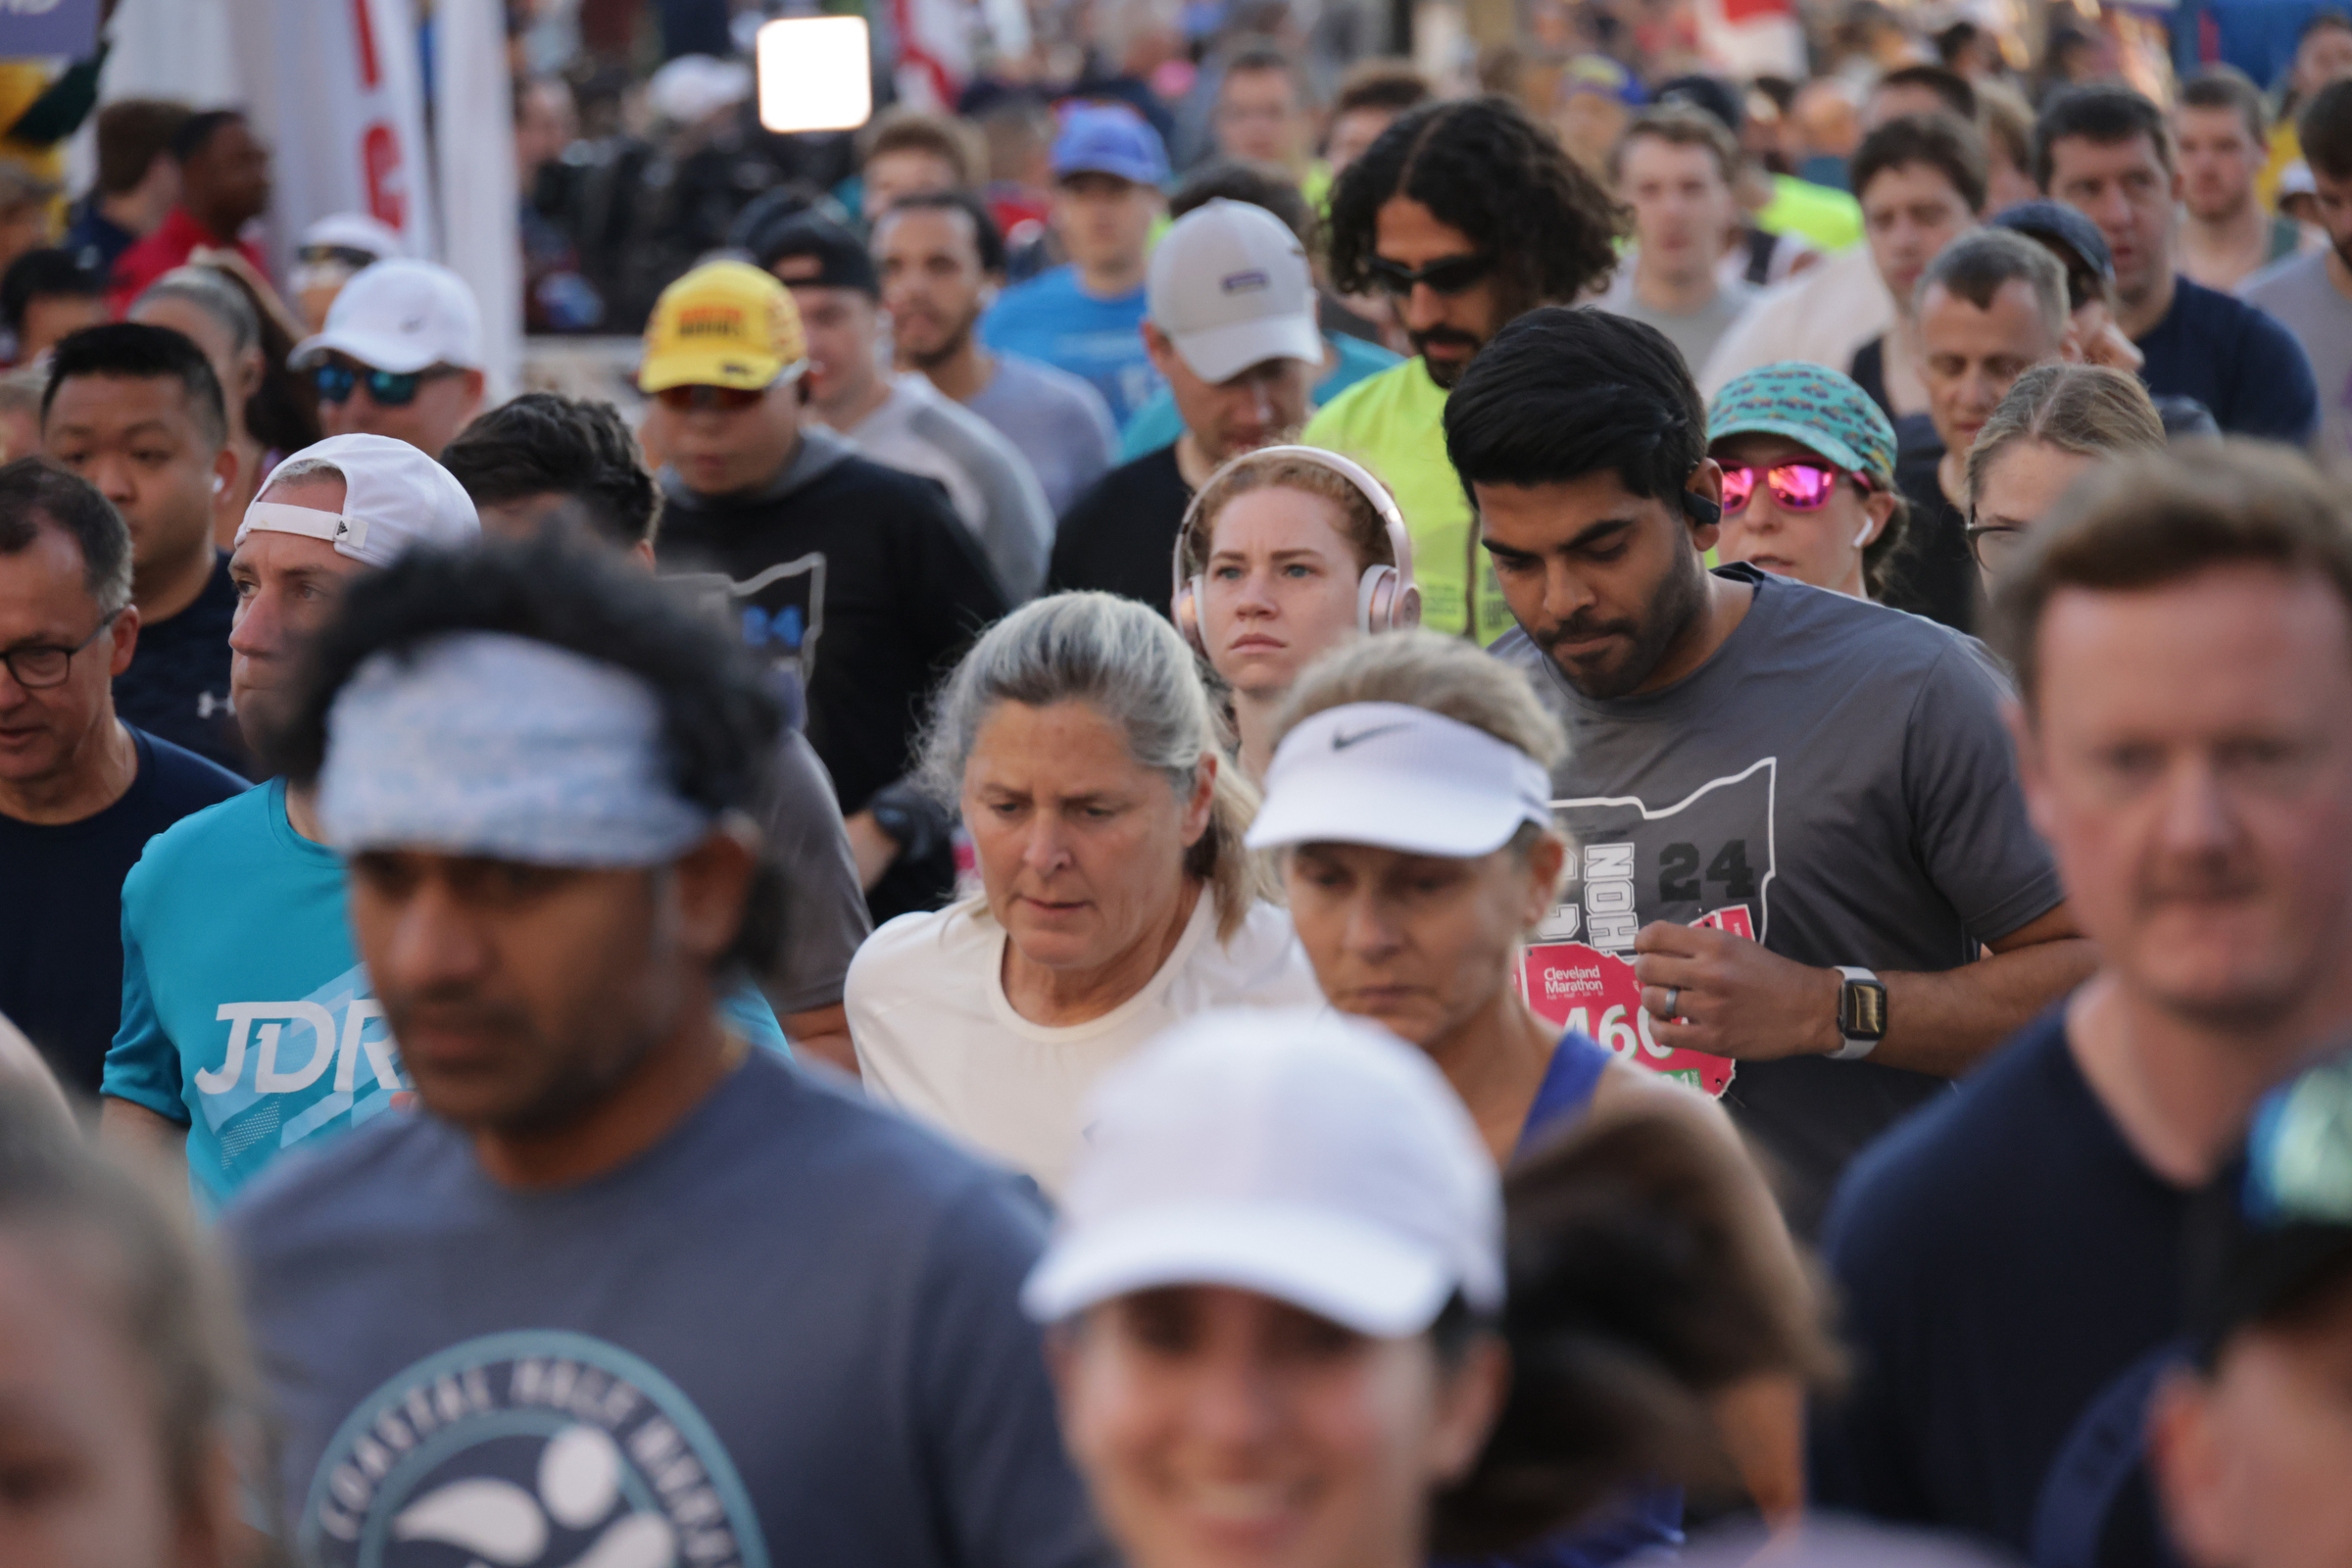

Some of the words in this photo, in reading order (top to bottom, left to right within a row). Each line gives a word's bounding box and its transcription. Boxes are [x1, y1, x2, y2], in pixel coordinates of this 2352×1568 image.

[1584, 842, 1640, 953] HON
[1659, 839, 1755, 902] 24
[1544, 965, 1601, 981] Cleveland
[1544, 979, 1604, 994] Marathon
[194, 998, 403, 1095] JDR
[1562, 1004, 1675, 1059] 460
